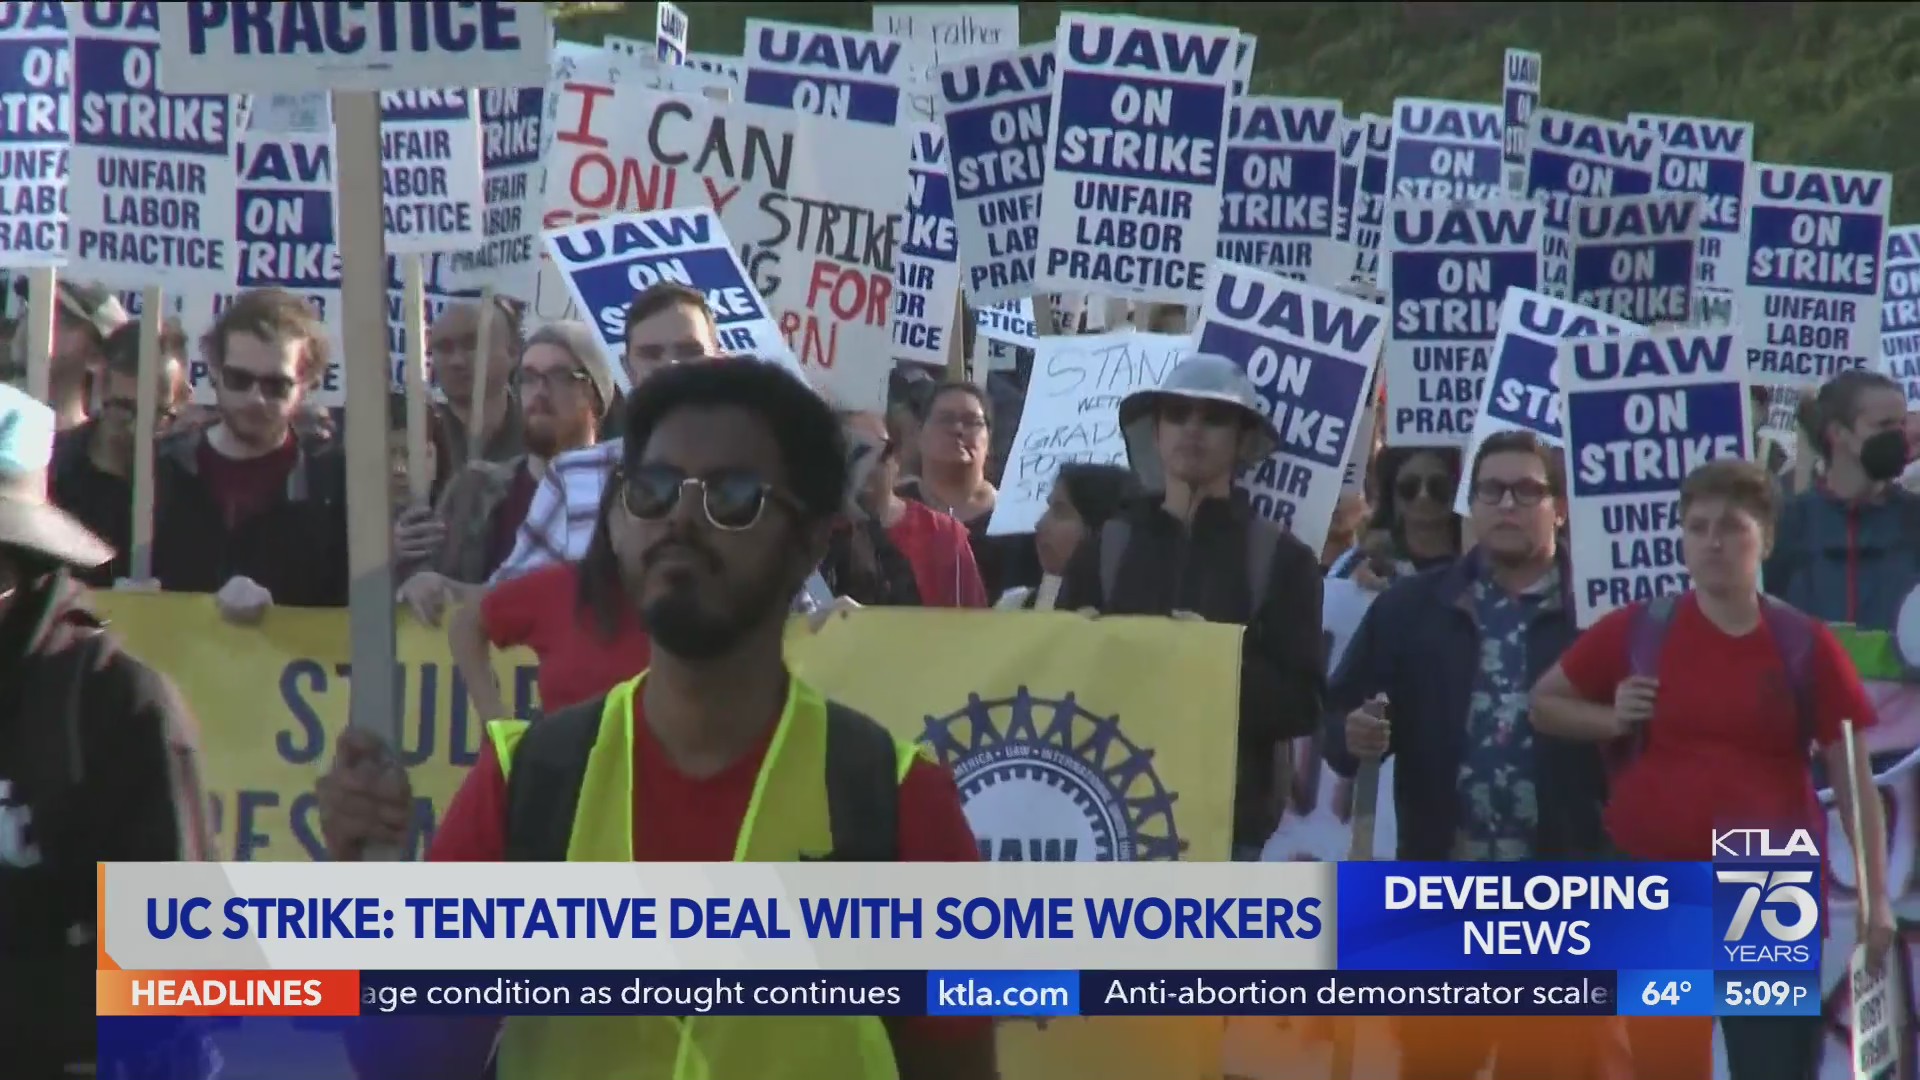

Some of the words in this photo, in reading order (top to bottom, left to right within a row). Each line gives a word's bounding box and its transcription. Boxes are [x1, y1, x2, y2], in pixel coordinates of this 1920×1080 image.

[188, 2, 521, 54] PRACTICE
[122, 46, 163, 88] O
[759, 27, 901, 75] UAW
[1068, 23, 1231, 76] UAW
[82, 90, 224, 143] STRIKE
[793, 81, 850, 120] ON
[1110, 84, 1173, 126] ON
[556, 82, 615, 148] I
[648, 101, 794, 191] CAN
[991, 103, 1043, 145] ON
[1540, 117, 1654, 162] UAW
[1060, 125, 1215, 177] STRIKE
[1429, 147, 1475, 178] ON
[97, 157, 207, 194] UNFAIR
[1242, 153, 1294, 189] ON
[1567, 162, 1614, 198] ON
[1664, 163, 1709, 190] ON
[1760, 170, 1885, 206] UAW
[102, 194, 201, 231] LABOR
[245, 198, 304, 236] ON
[979, 193, 1042, 228] UNF
[1073, 180, 1193, 221] UNFAIR
[1218, 192, 1329, 231] TRIKE
[553, 214, 712, 263] UAW
[759, 192, 903, 274] STRIKE
[1075, 215, 1183, 254] LABOR
[1394, 209, 1537, 245] UAW
[1579, 201, 1698, 240] UAW
[1791, 214, 1843, 248] ON
[79, 228, 225, 270] PRACTICE
[1609, 249, 1656, 284] ON
[1752, 248, 1877, 286] STRIKE
[627, 258, 694, 293] ON
[1046, 247, 1207, 291] PRACTICE
[1437, 259, 1491, 294] ON
[806, 260, 895, 328] FOR
[1764, 295, 1858, 326] UNFAIR
[1216, 274, 1381, 354] UAW
[1767, 322, 1850, 351] LABOR
[1047, 342, 1180, 398] STAN
[1246, 344, 1313, 397] ON
[1412, 346, 1495, 372] UNFA
[1574, 335, 1734, 381] UAW
[1623, 390, 1687, 434] ON
